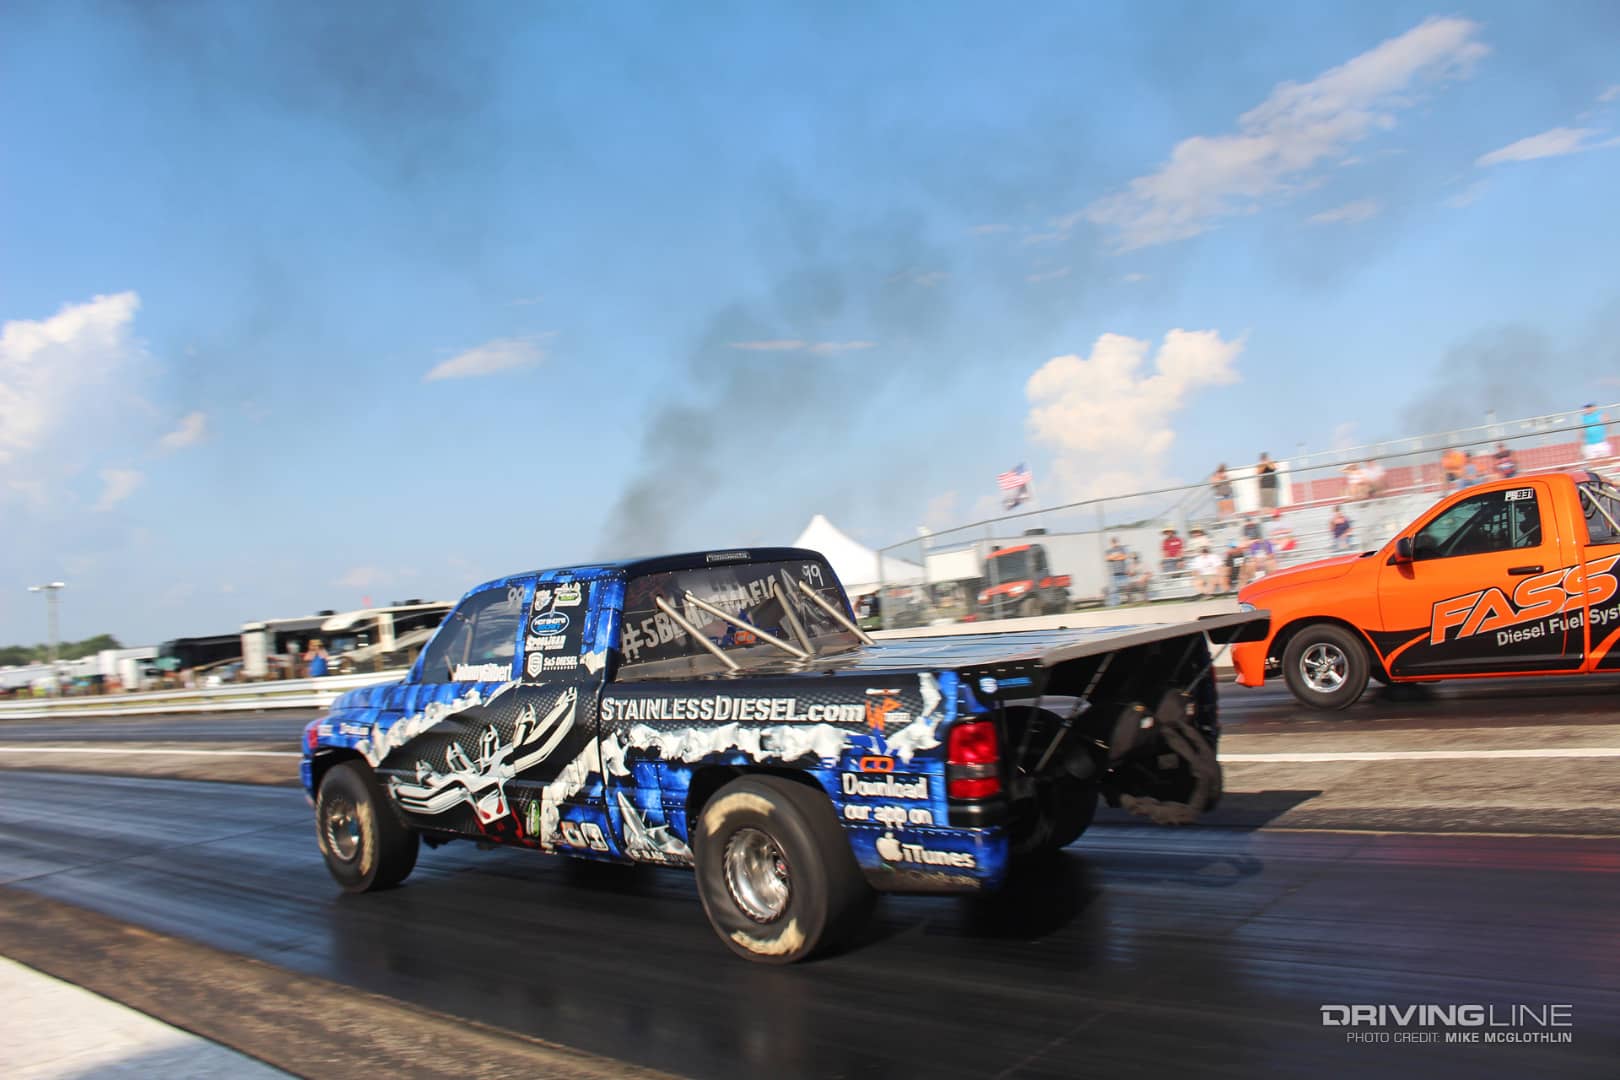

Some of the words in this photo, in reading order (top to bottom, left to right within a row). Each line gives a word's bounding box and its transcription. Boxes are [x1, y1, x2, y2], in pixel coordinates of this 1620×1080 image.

[1431, 555, 1620, 645] FASS
[1497, 622, 1544, 646] Diesel
[1549, 613, 1584, 634] Fuel
[842, 773, 928, 799] Download
[844, 805, 872, 820] our
[874, 806, 906, 831] app
[909, 809, 933, 824] on
[902, 843, 976, 868] iTunes
